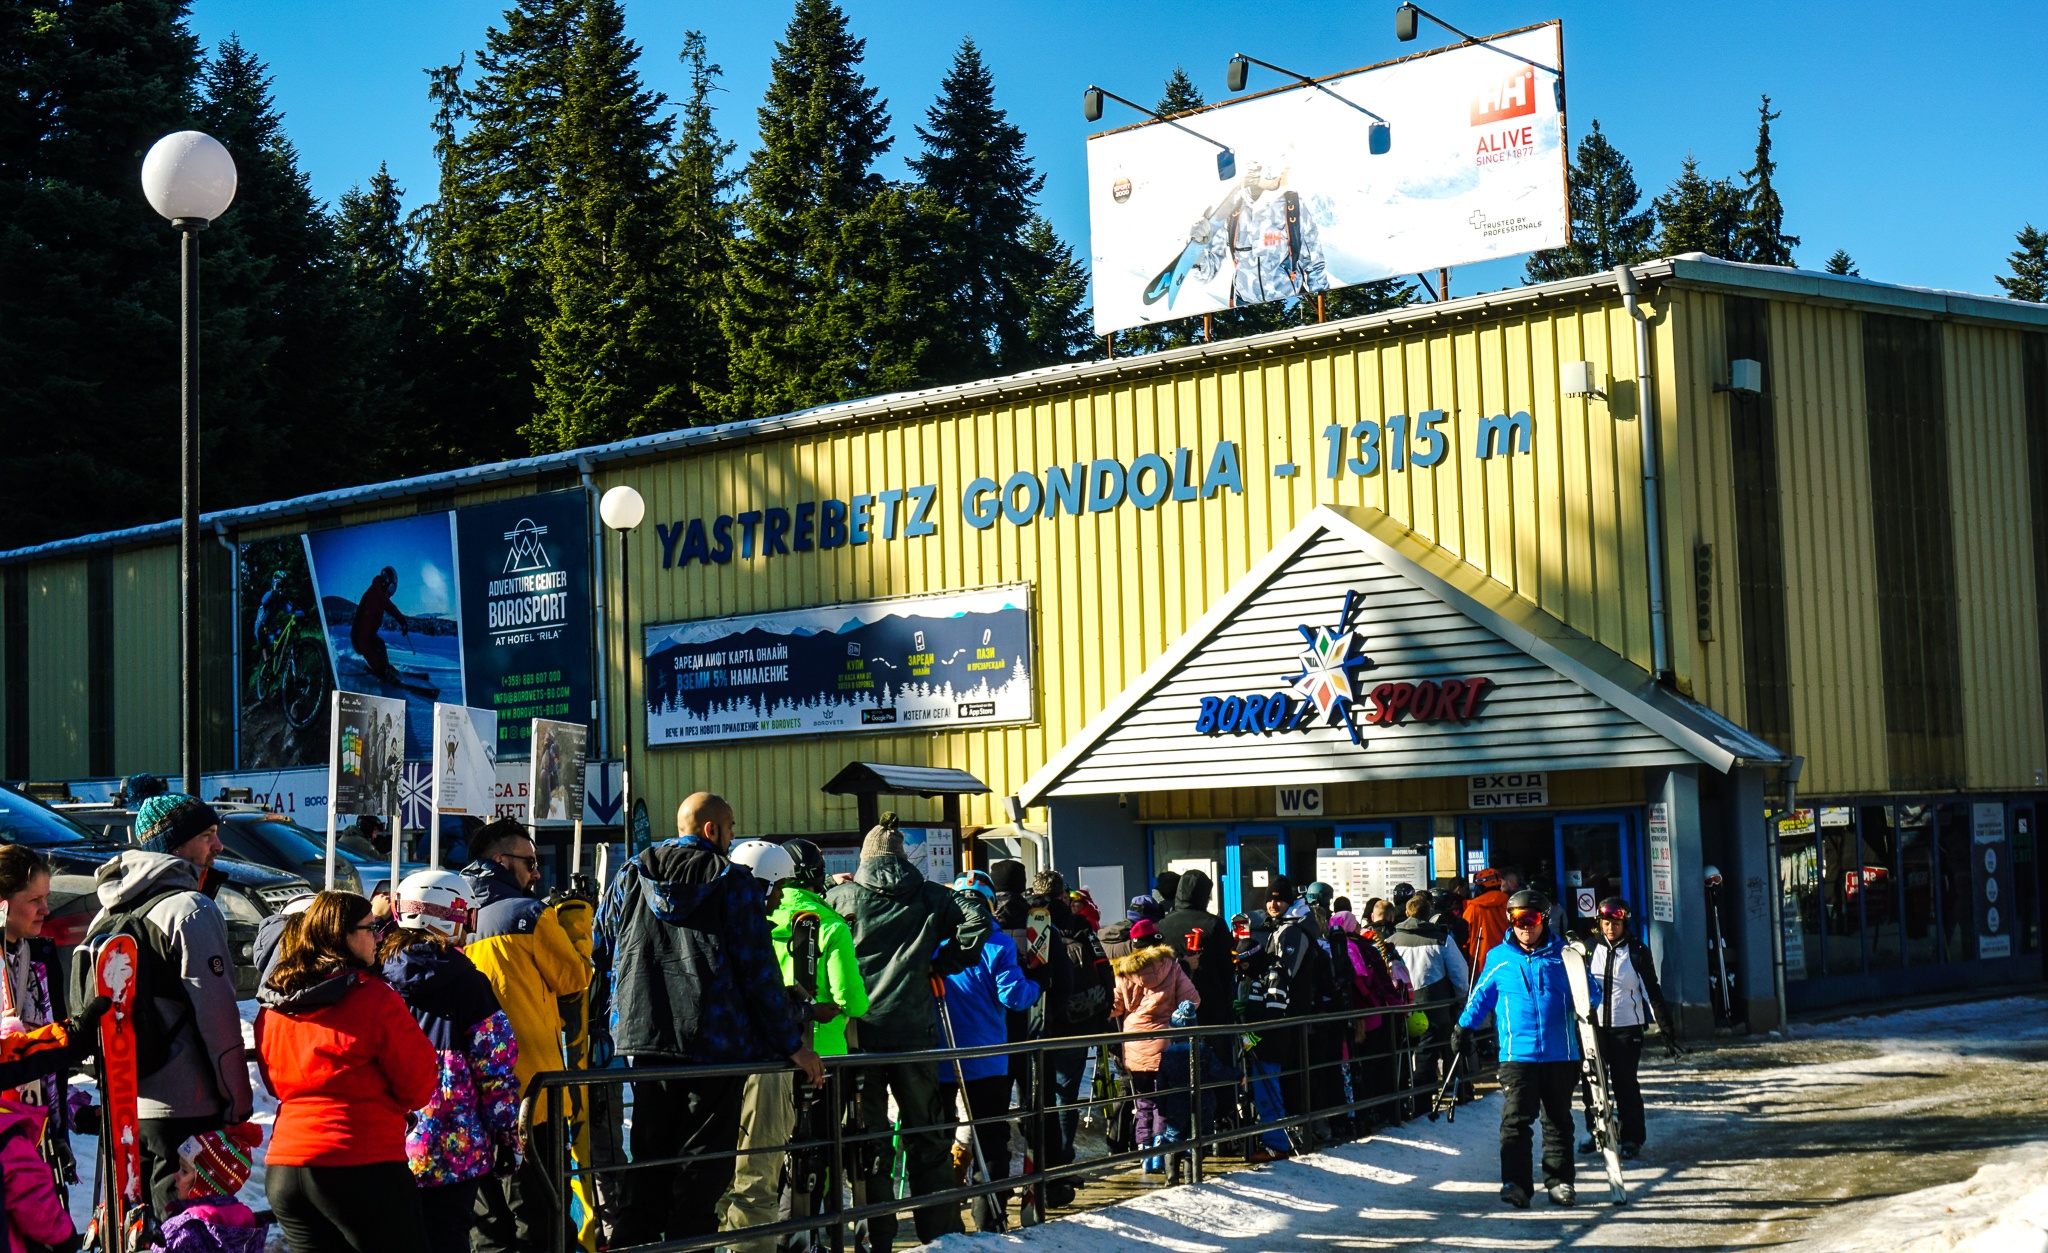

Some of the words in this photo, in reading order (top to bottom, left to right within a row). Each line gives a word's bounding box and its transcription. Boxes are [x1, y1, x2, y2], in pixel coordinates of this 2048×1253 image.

[1476, 126, 1533, 155] ALIVE
[1476, 151, 1504, 166] SINCE
[1513, 146, 1534, 159] 1877
[1483, 218, 1515, 229] TRUSTED
[1516, 216, 1526, 225] BY
[1483, 220, 1542, 237] PROFESSIONALS
[656, 484, 937, 569] YASTREBETZ
[962, 440, 1243, 529] GONDOLA
[1321, 408, 1446, 479] 1315
[1475, 410, 1532, 459] m
[488, 575, 535, 597] ADVENTURE
[535, 570, 567, 591] CENTER
[488, 592, 568, 628] BOROSPORT
[495, 636, 506, 646] AT
[507, 633, 535, 645] HOTEL
[674, 655, 703, 671] ЗАРЕДИ
[705, 651, 727, 667] ЛИФТ
[728, 649, 755, 665] КАРТА
[756, 642, 788, 662] ОНЛАЙН
[908, 653, 935, 666] ЗАРЕДИ
[976, 647, 995, 659] ПАЗИ
[501, 674, 522, 687] (+359)
[522, 673, 535, 685] 889
[535, 672, 547, 684] 607
[548, 670, 561, 681] 000
[676, 669, 710, 691] ВЗЕМИ
[713, 669, 728, 687] 5%
[730, 664, 789, 686] НАМАЛЕНИЕ
[493, 686, 570, 704] INFO@BOROVETS-BG.COM
[1365, 677, 1490, 723] SPORT
[871, 713, 886, 722] Google
[886, 713, 895, 721] Play
[903, 709, 931, 721] ИЗТЕГЛИ
[932, 707, 951, 718] СЕГА!
[968, 708, 979, 717] App
[979, 707, 993, 715] Store
[1195, 692, 1287, 733] BORO
[665, 727, 678, 738] ВЕЧЕ
[679, 727, 684, 736] И
[685, 725, 699, 736] ПРЕЗ
[700, 723, 721, 736] НОВОТО
[722, 720, 759, 733] ПРИЛОЖЕНИЕ
[760, 719, 770, 730] MY
[771, 717, 802, 729] BOROVETS
[813, 719, 844, 727] BOROVETS
[1472, 773, 1542, 788] ВХОД
[288, 792, 295, 812] 1
[1280, 788, 1319, 811] WC
[1473, 791, 1542, 806] ENTER
